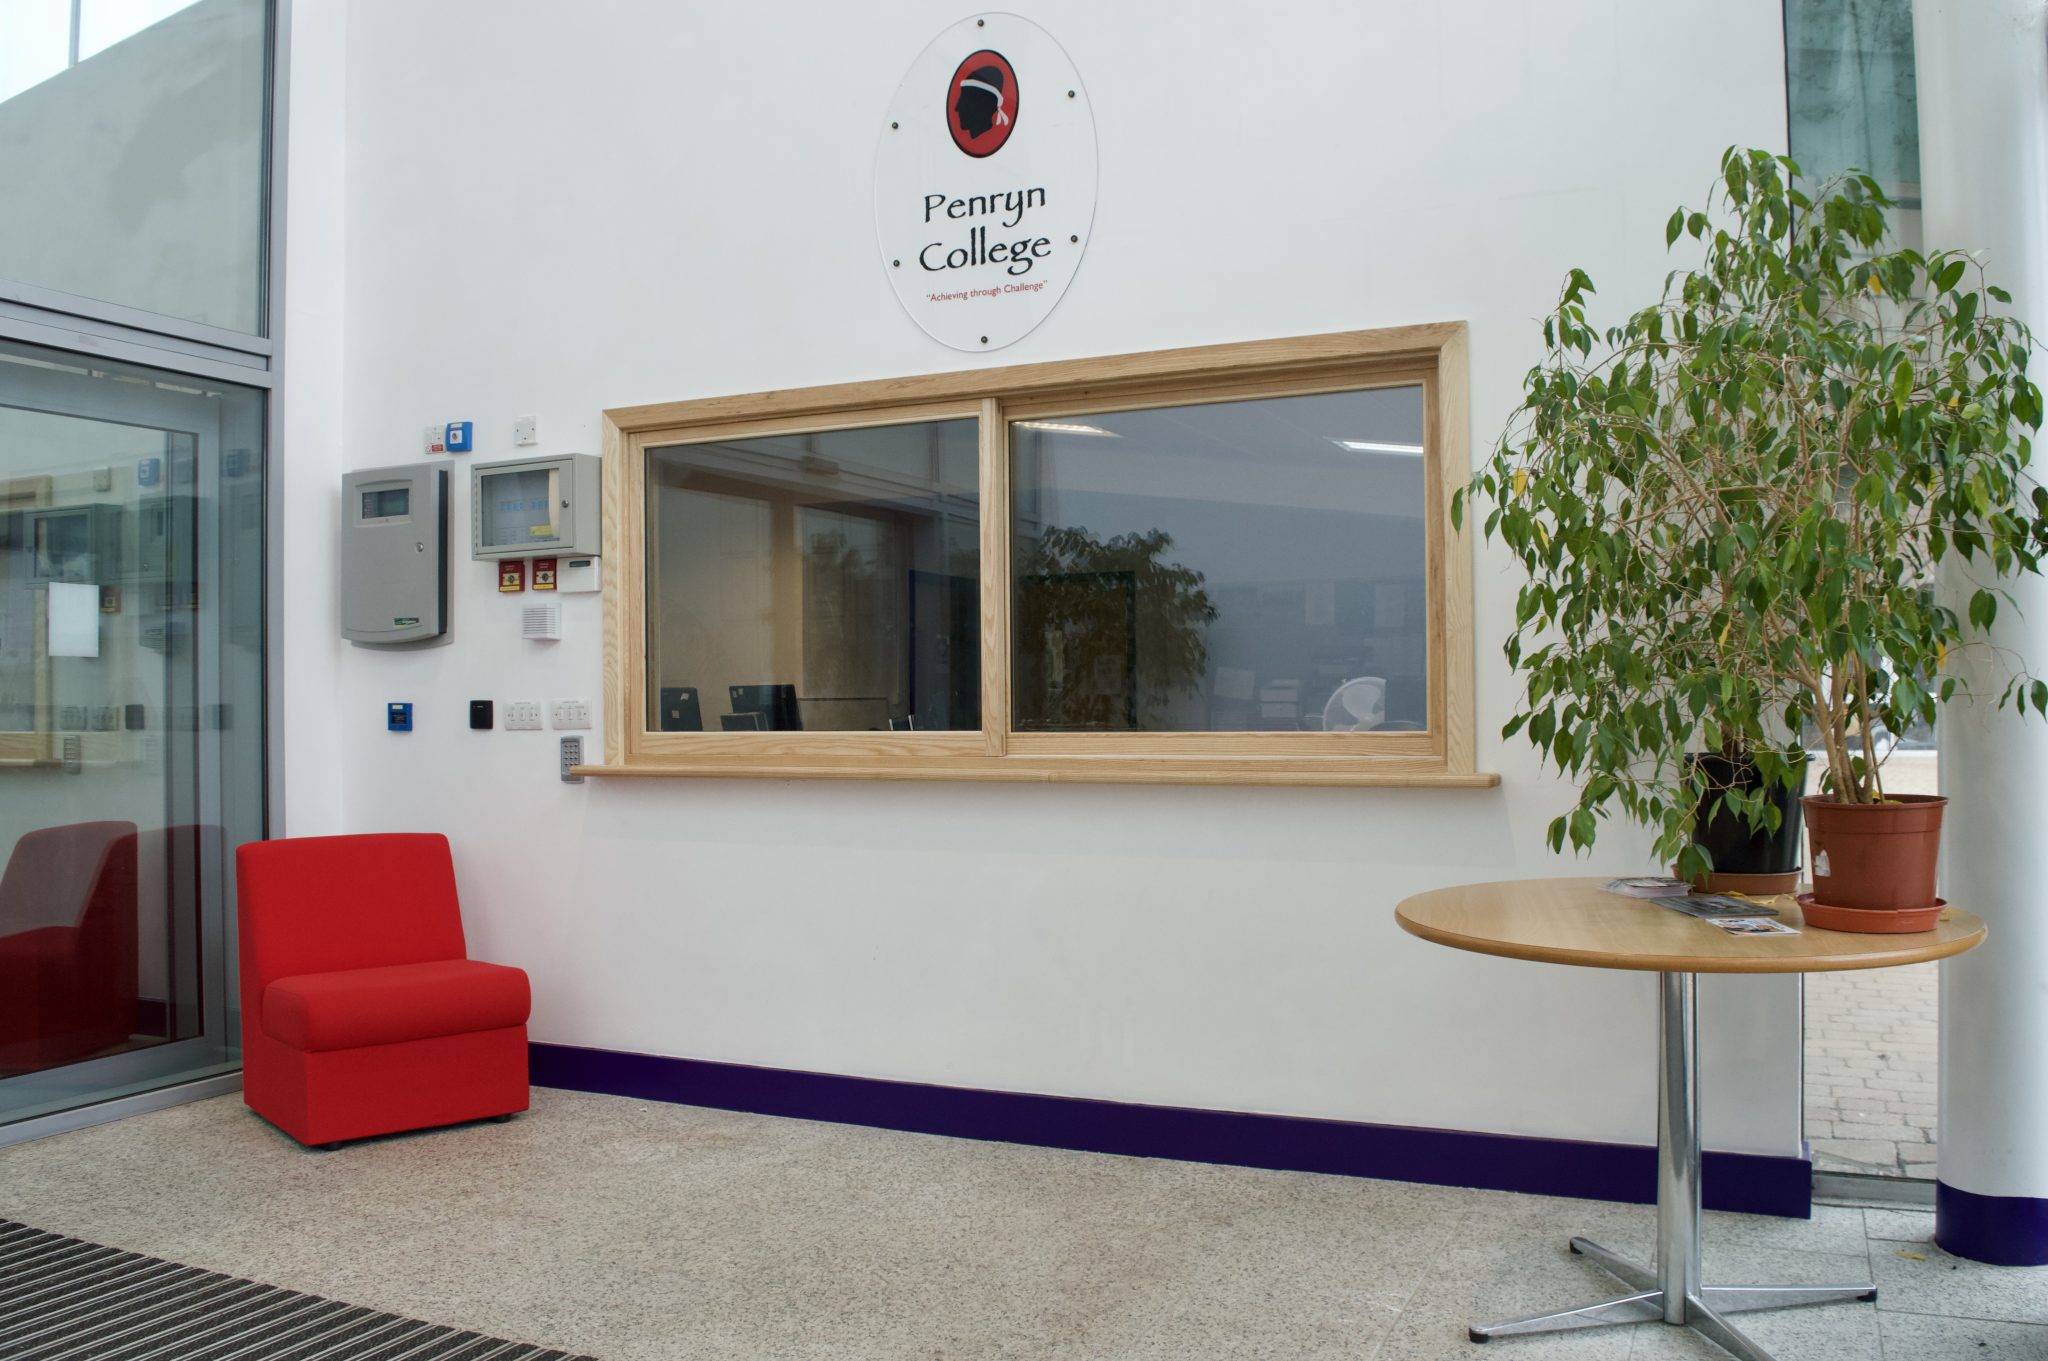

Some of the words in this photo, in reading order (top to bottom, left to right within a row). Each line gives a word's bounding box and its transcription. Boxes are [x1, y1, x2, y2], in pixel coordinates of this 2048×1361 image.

[924, 187, 1046, 228] Penryn
[919, 226, 1051, 275] College
[970, 286, 1001, 297] through
